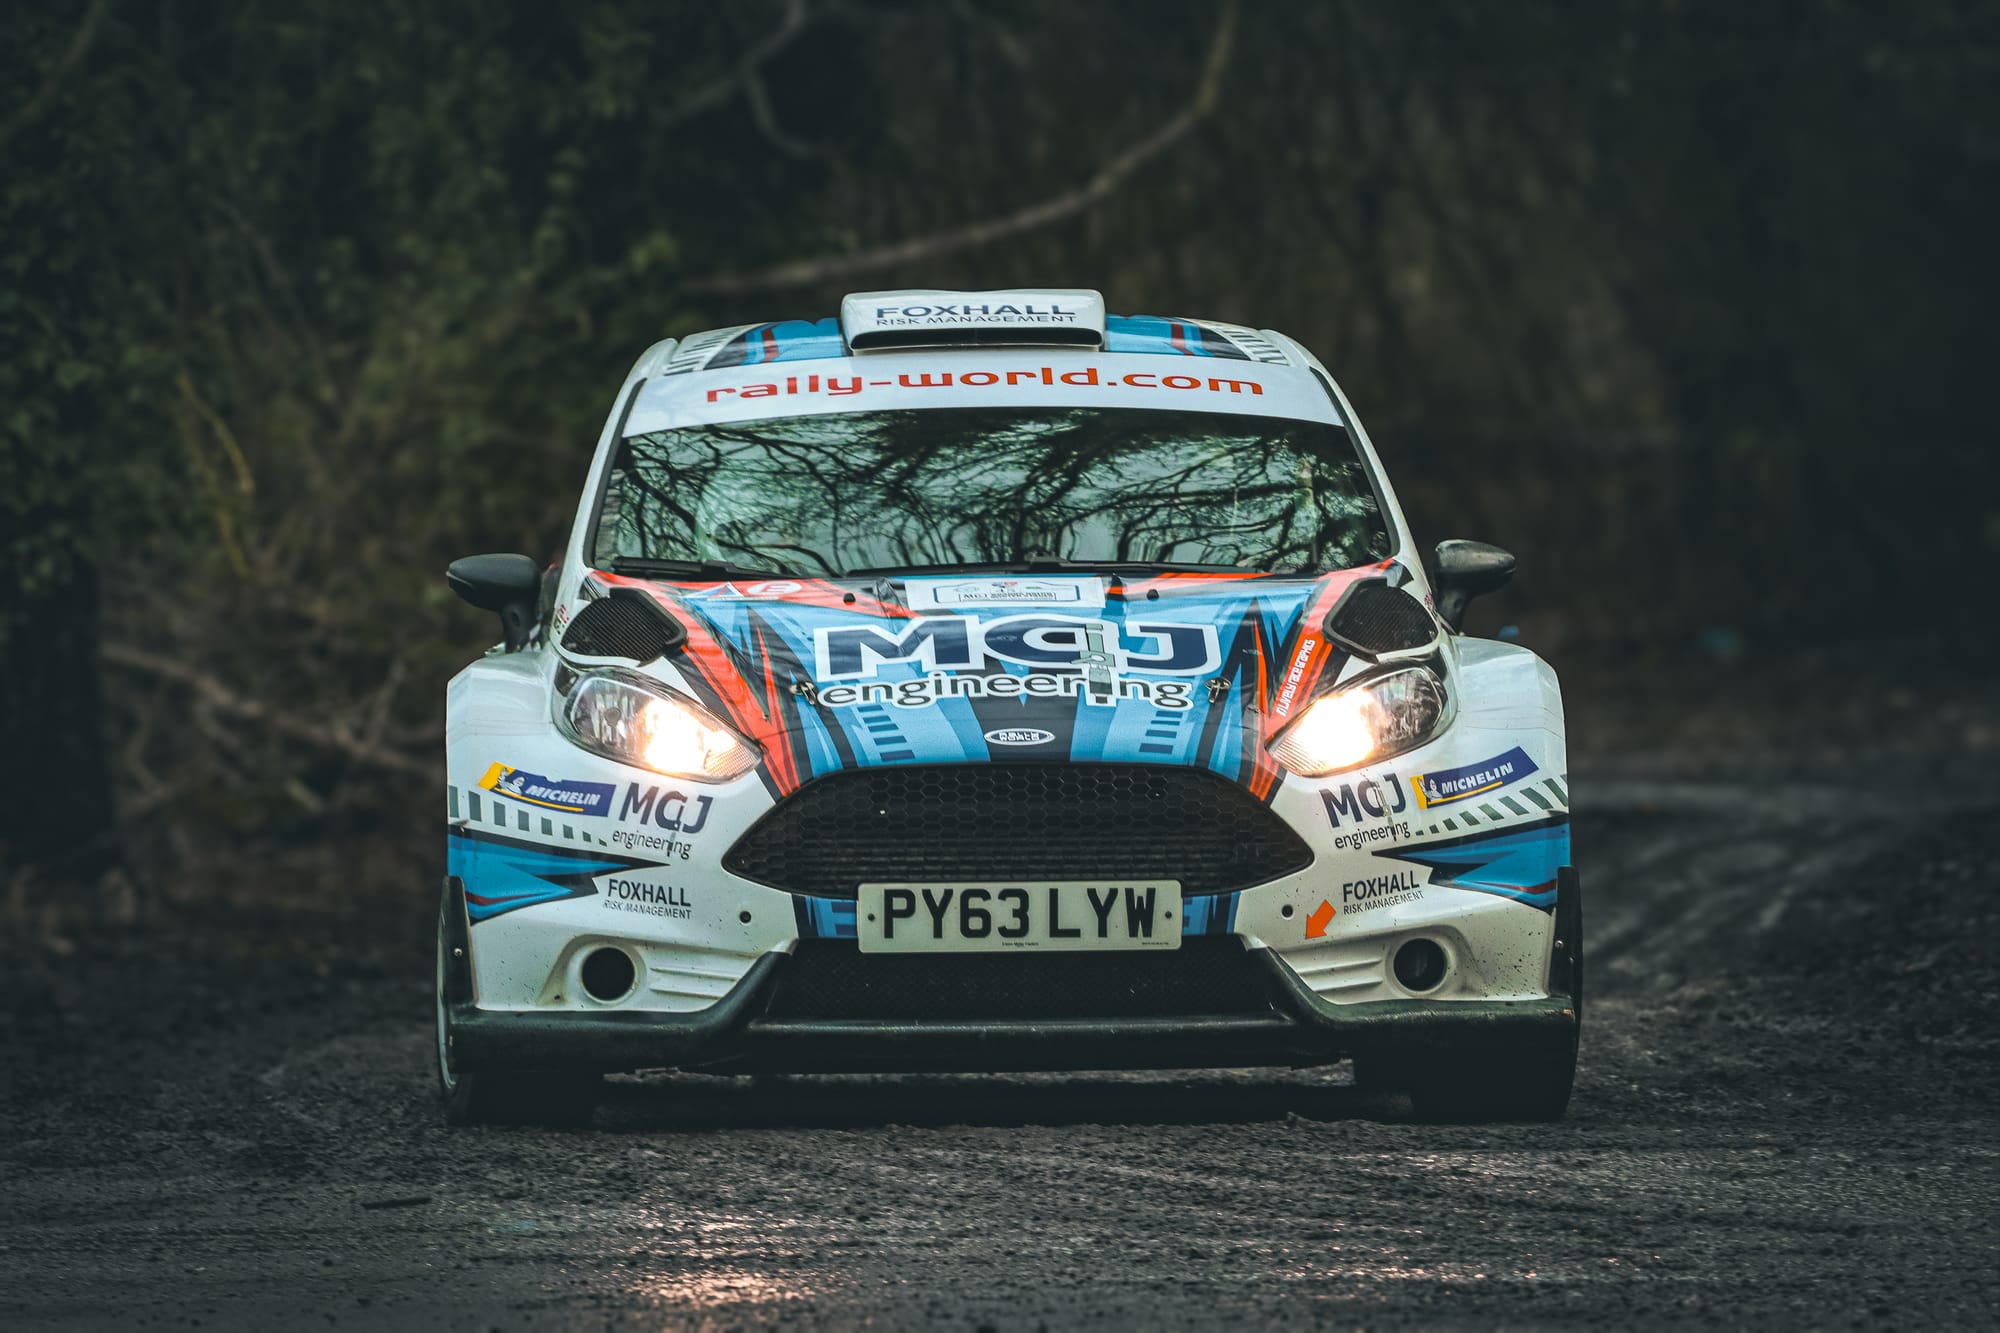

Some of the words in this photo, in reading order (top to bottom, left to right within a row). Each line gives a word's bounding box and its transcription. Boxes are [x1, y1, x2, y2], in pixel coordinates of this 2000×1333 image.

[876, 304, 1076, 319] FOXHALL
[876, 318, 920, 326] RISK
[926, 315, 1078, 325] MANAGEMENT
[706, 366, 1264, 403] rally-world.com
[1440, 761, 1515, 795] MICHELIN
[526, 784, 602, 807] MICHELIN
[618, 781, 714, 835] MGJ
[612, 829, 693, 861] engineering
[1334, 820, 1410, 850] engineering
[607, 878, 692, 907] FOXHALL
[1342, 870, 1420, 903] FOXHALL
[602, 899, 623, 912] RISK
[625, 902, 692, 921] MANAGEMENT
[883, 887, 1030, 939] PY63
[1048, 887, 1156, 938] LYW
[1342, 904, 1363, 915] RISK
[1364, 891, 1425, 912] MANAGEMENT
